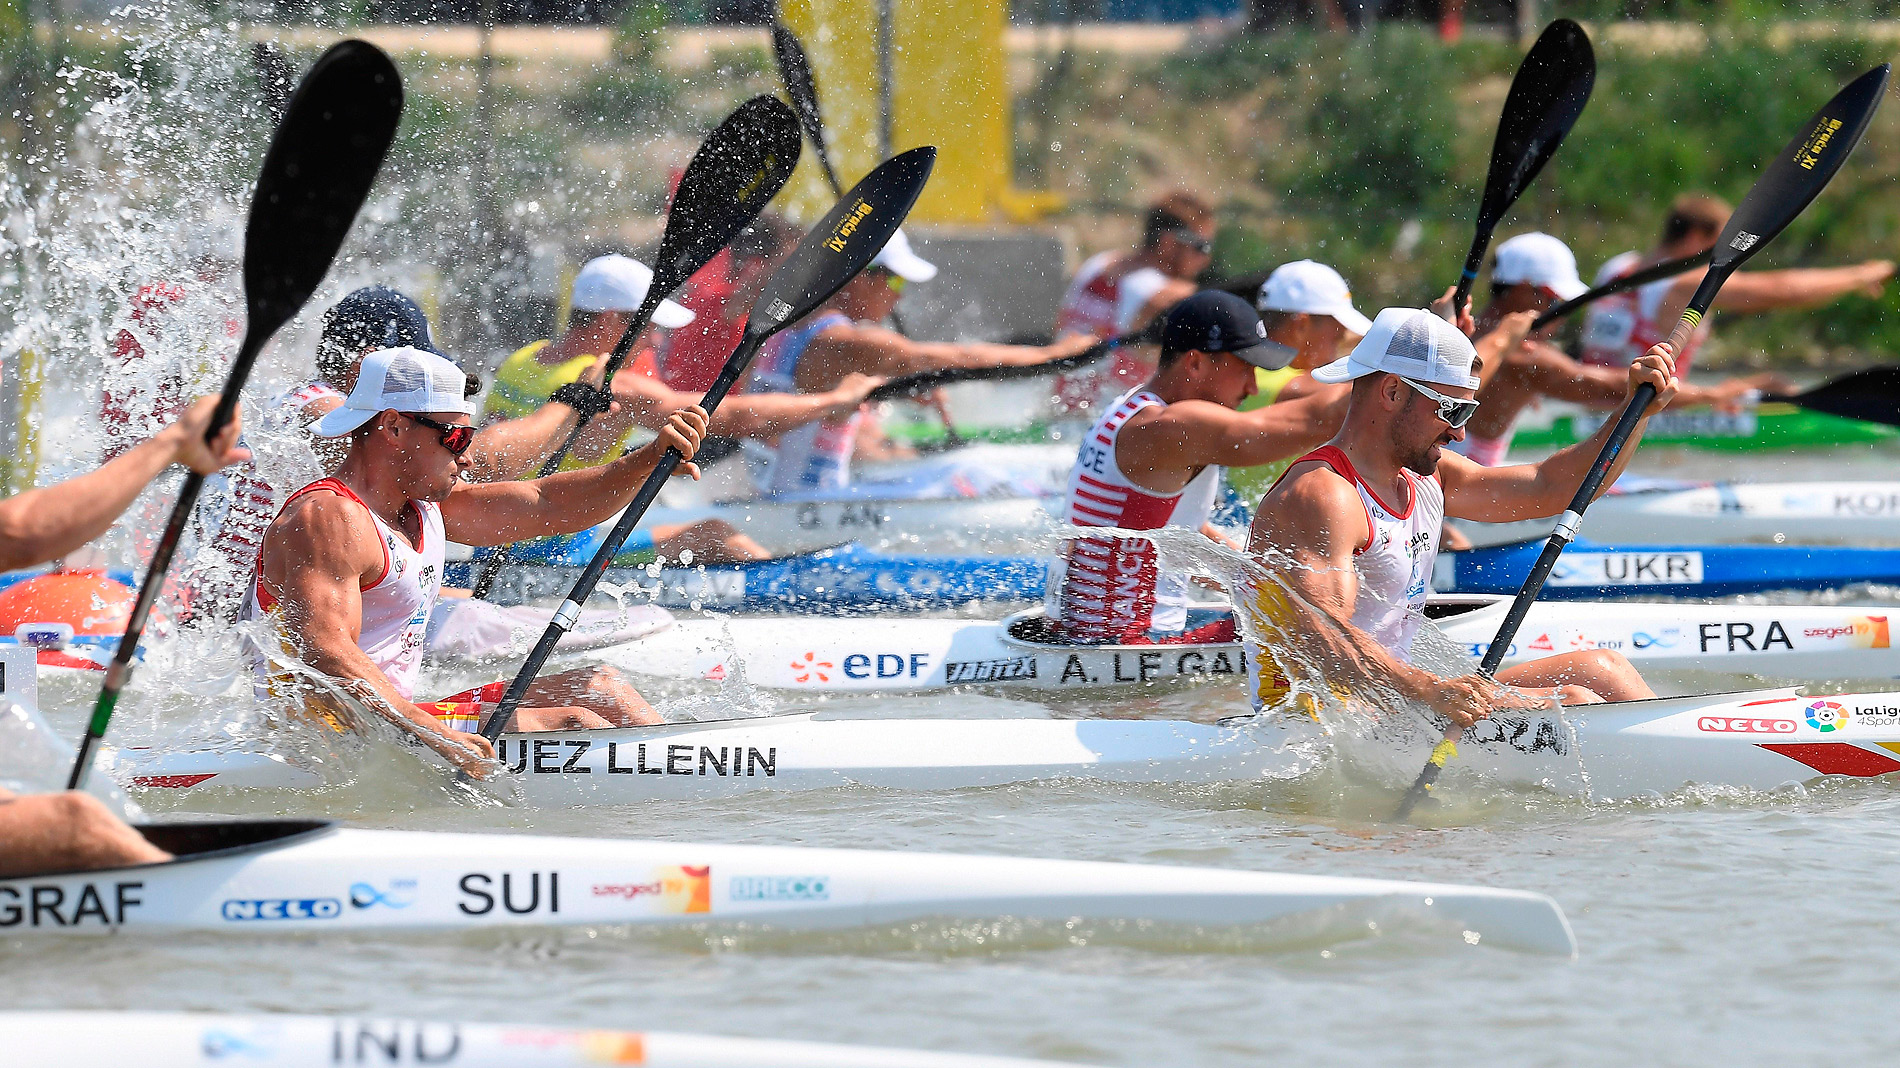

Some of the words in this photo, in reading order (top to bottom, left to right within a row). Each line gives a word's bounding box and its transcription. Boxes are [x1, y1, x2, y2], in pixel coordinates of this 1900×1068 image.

[1604, 556, 1691, 581] UKR
[1699, 621, 1794, 652] FRA
[1701, 718, 1795, 732] NELO
[1855, 705, 1900, 717] LaLig
[608, 742, 776, 777] LLENIN
[0, 883, 144, 926] GRAF
[459, 872, 559, 915] SUI
[225, 901, 340, 920] NELO
[333, 1020, 461, 1065] IND
